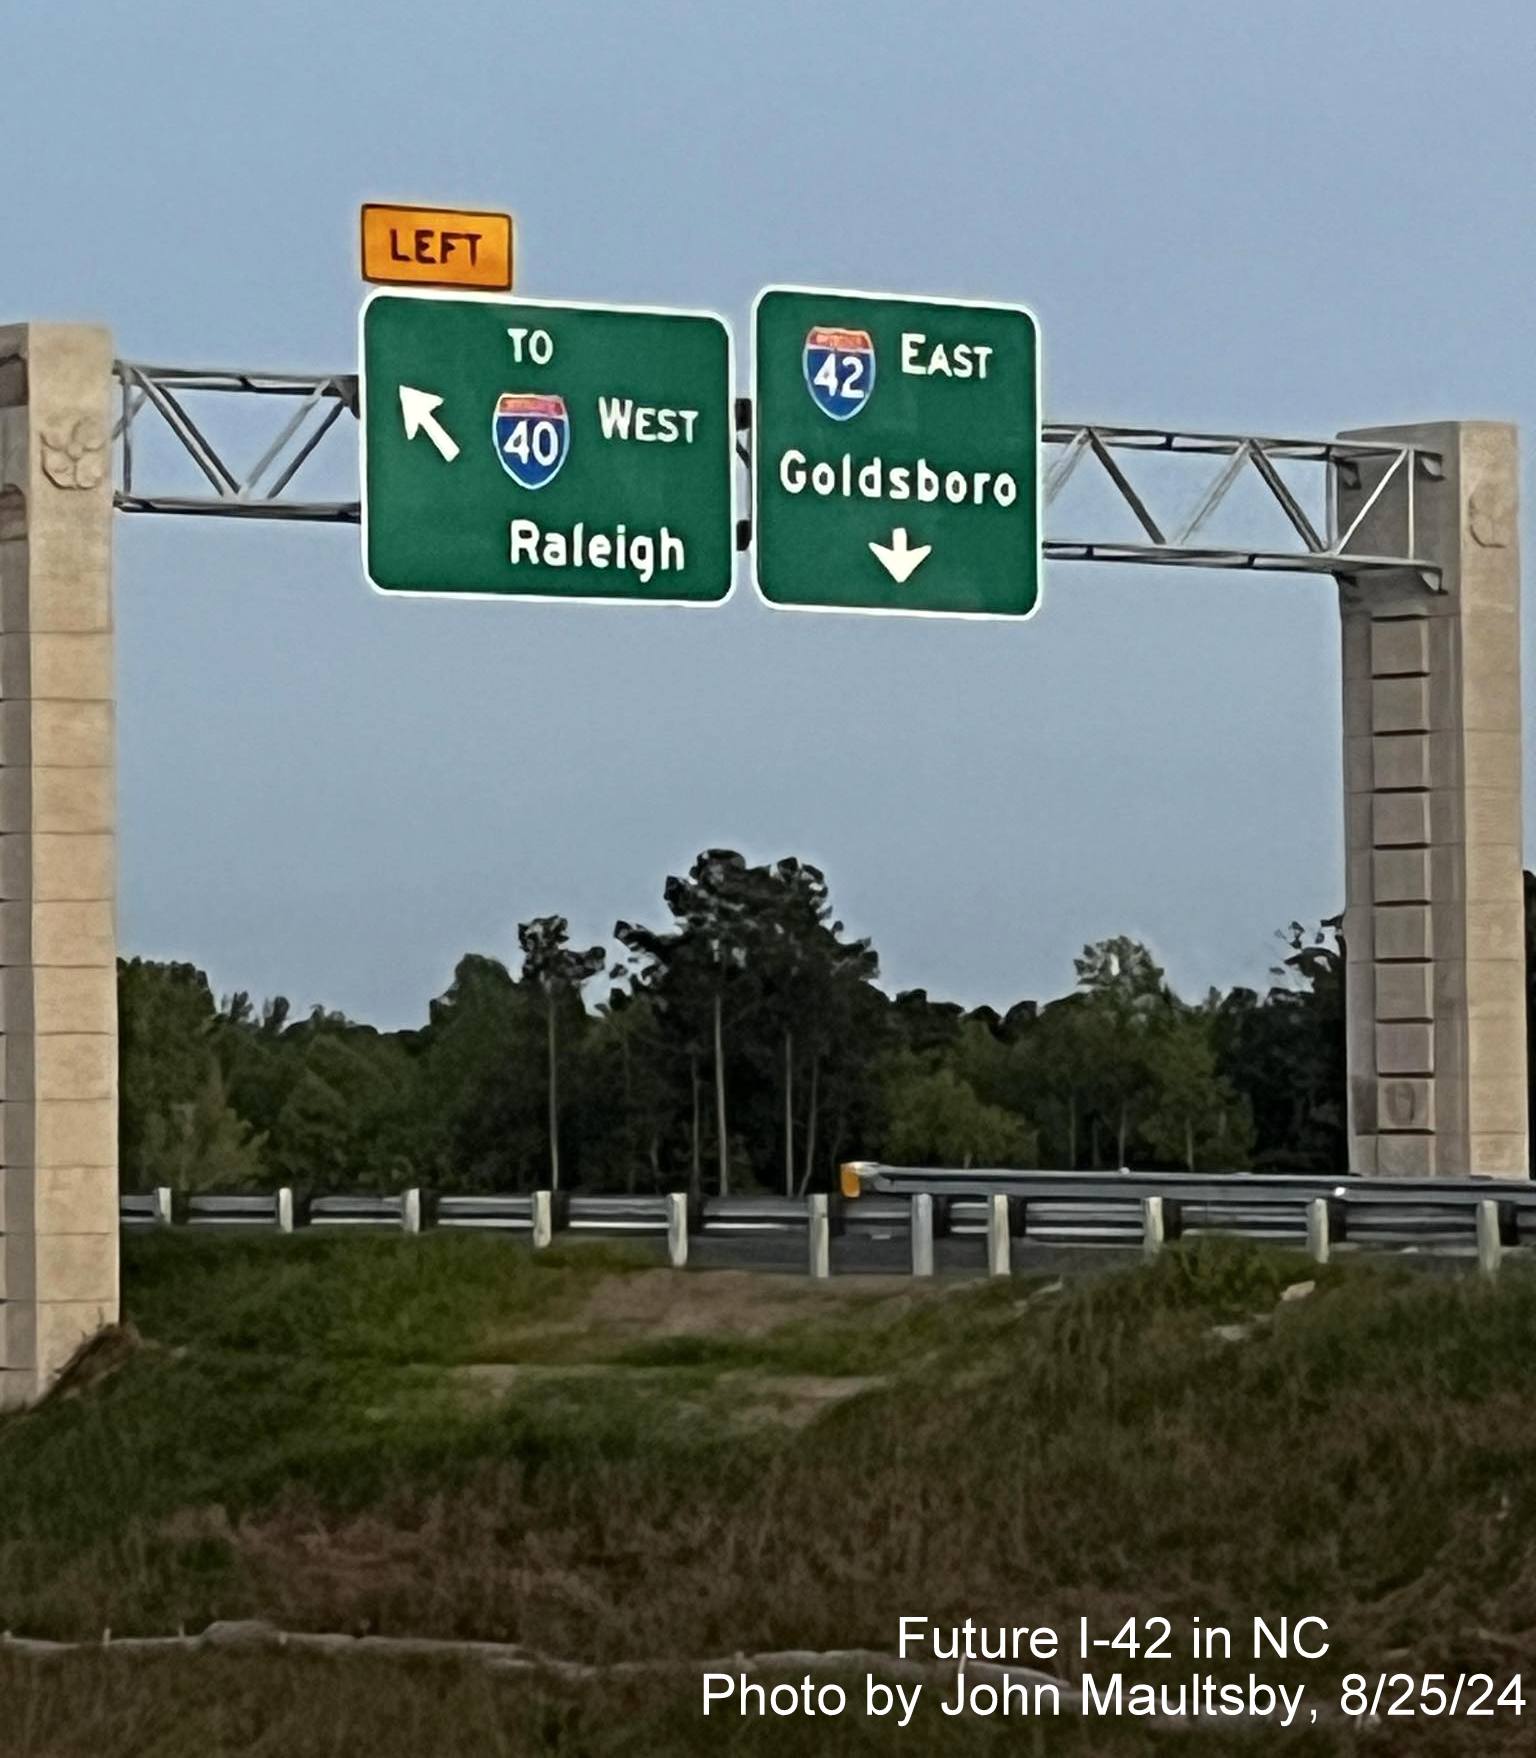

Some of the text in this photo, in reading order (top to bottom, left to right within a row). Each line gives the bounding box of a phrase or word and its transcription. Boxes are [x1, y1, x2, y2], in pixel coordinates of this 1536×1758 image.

[389, 228, 482, 268] LEFT
[507, 327, 554, 365] TO
[813, 332, 993, 399] 42 EAST
[503, 396, 699, 466] 40 WEST
[780, 449, 1017, 507] Goldsboro
[510, 519, 685, 582] Raleigh
